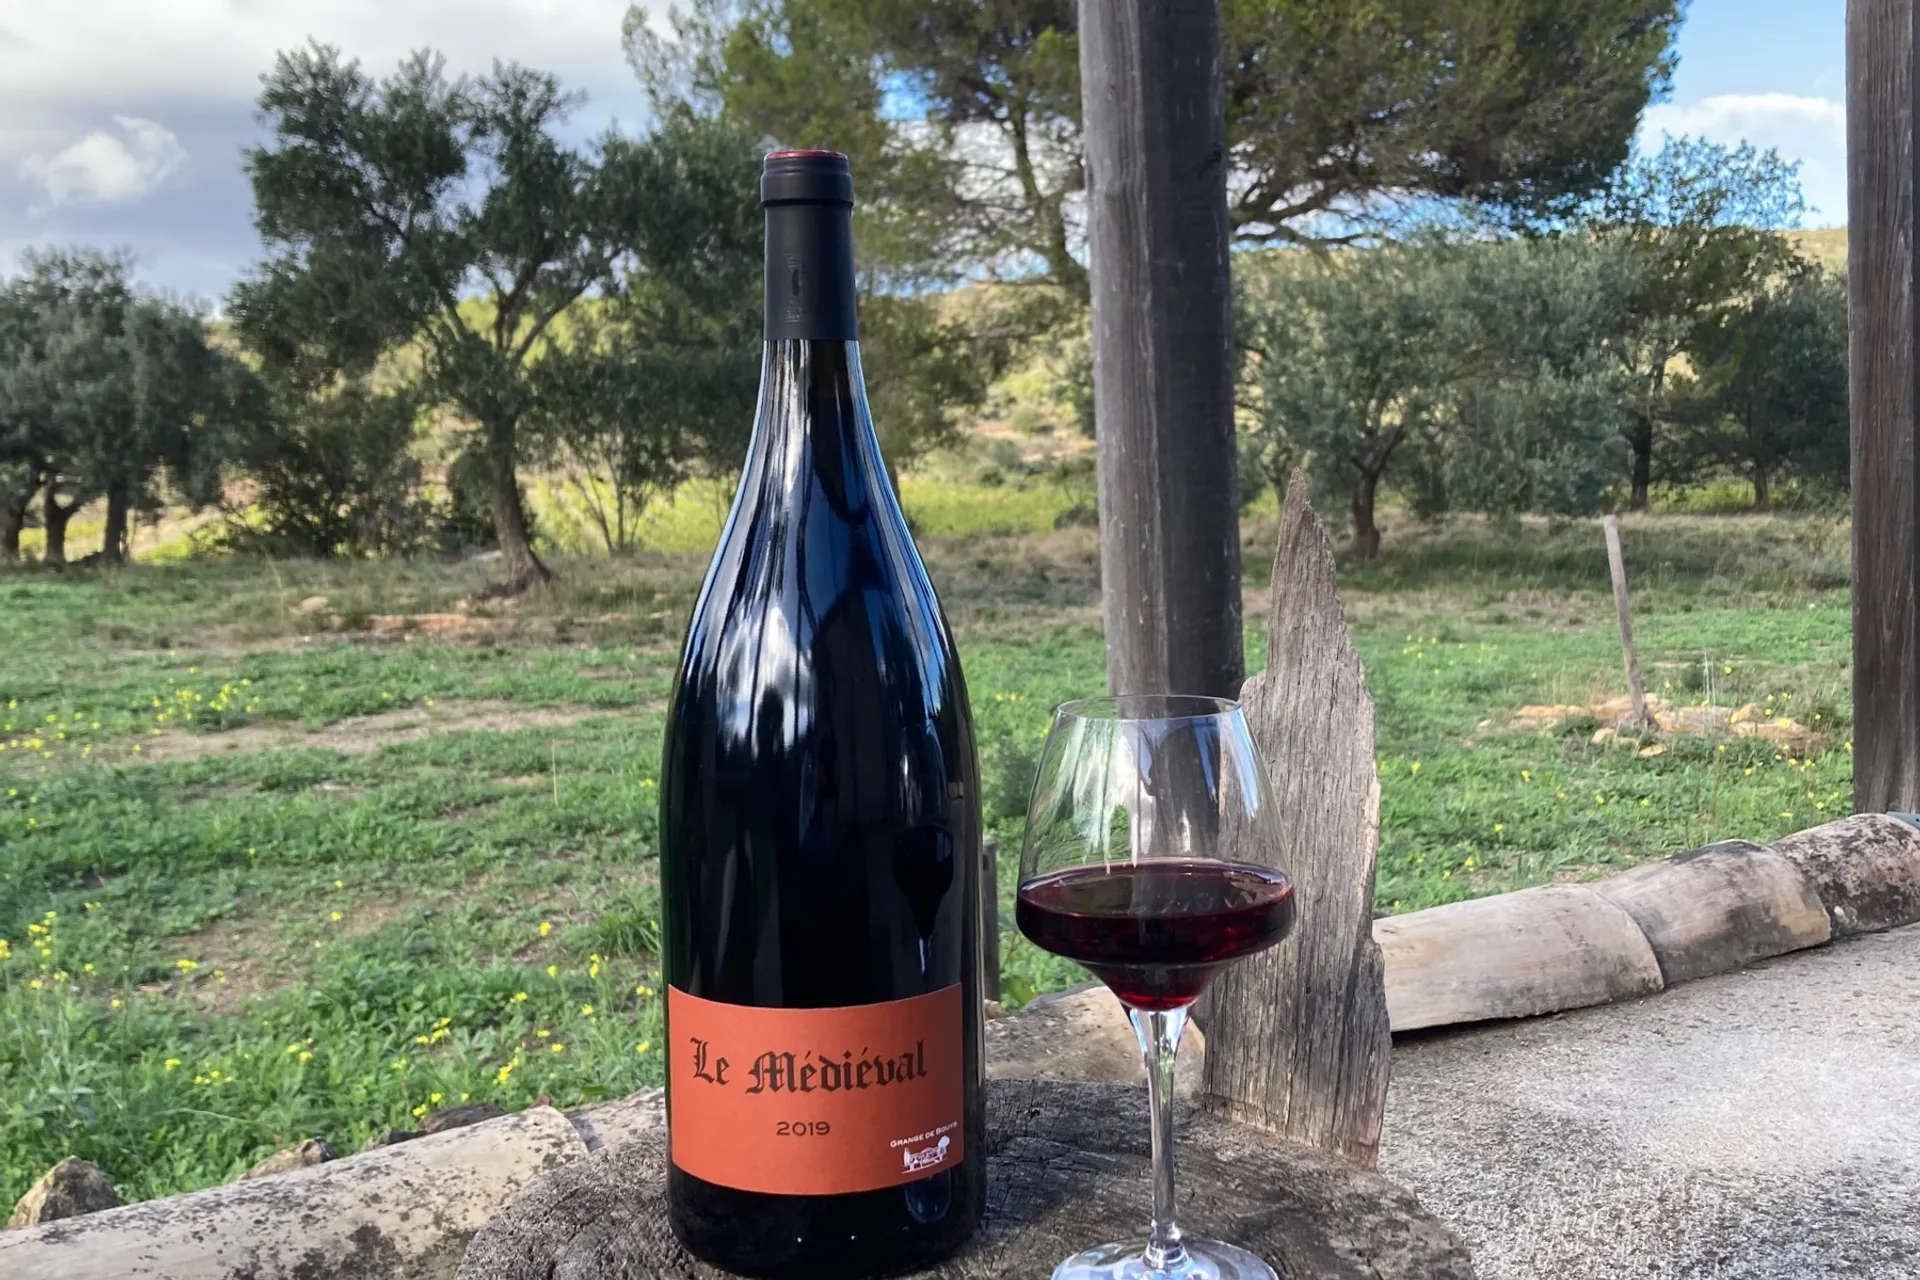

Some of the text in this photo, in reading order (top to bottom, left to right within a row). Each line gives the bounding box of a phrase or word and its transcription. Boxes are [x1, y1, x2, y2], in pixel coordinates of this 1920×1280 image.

[690, 1037, 928, 1095] Le Médiéval
[776, 1121, 831, 1137] 2019
[889, 1133, 924, 1148] GRANGE
[924, 1129, 935, 1140] DE
